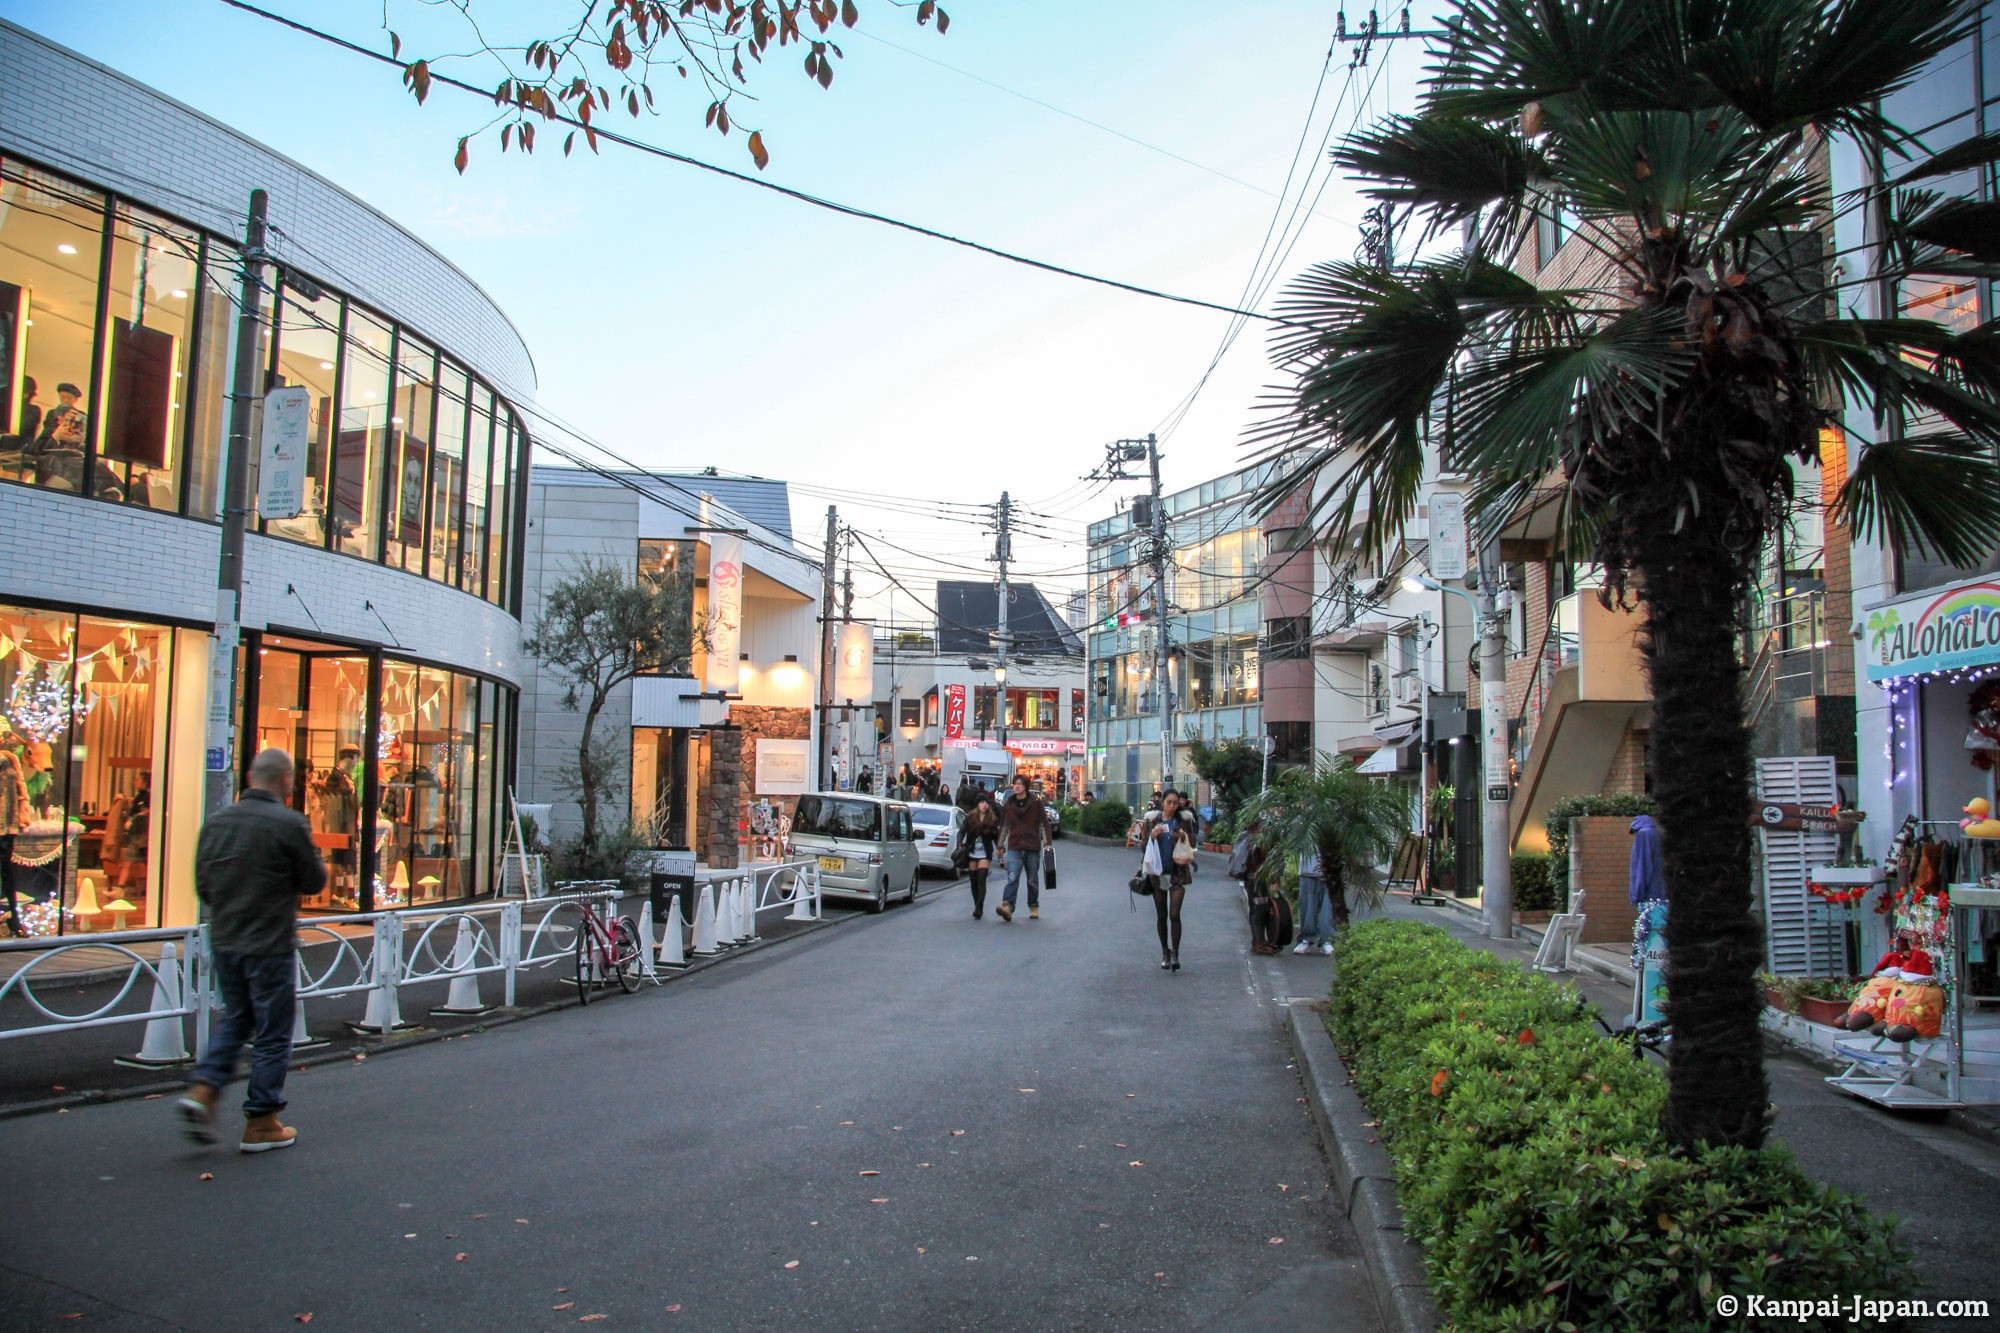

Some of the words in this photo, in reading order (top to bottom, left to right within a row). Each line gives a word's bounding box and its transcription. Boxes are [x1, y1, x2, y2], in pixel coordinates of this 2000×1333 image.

[950, 696, 963, 735] ケバブ
[1800, 807, 1834, 818] KAILU
